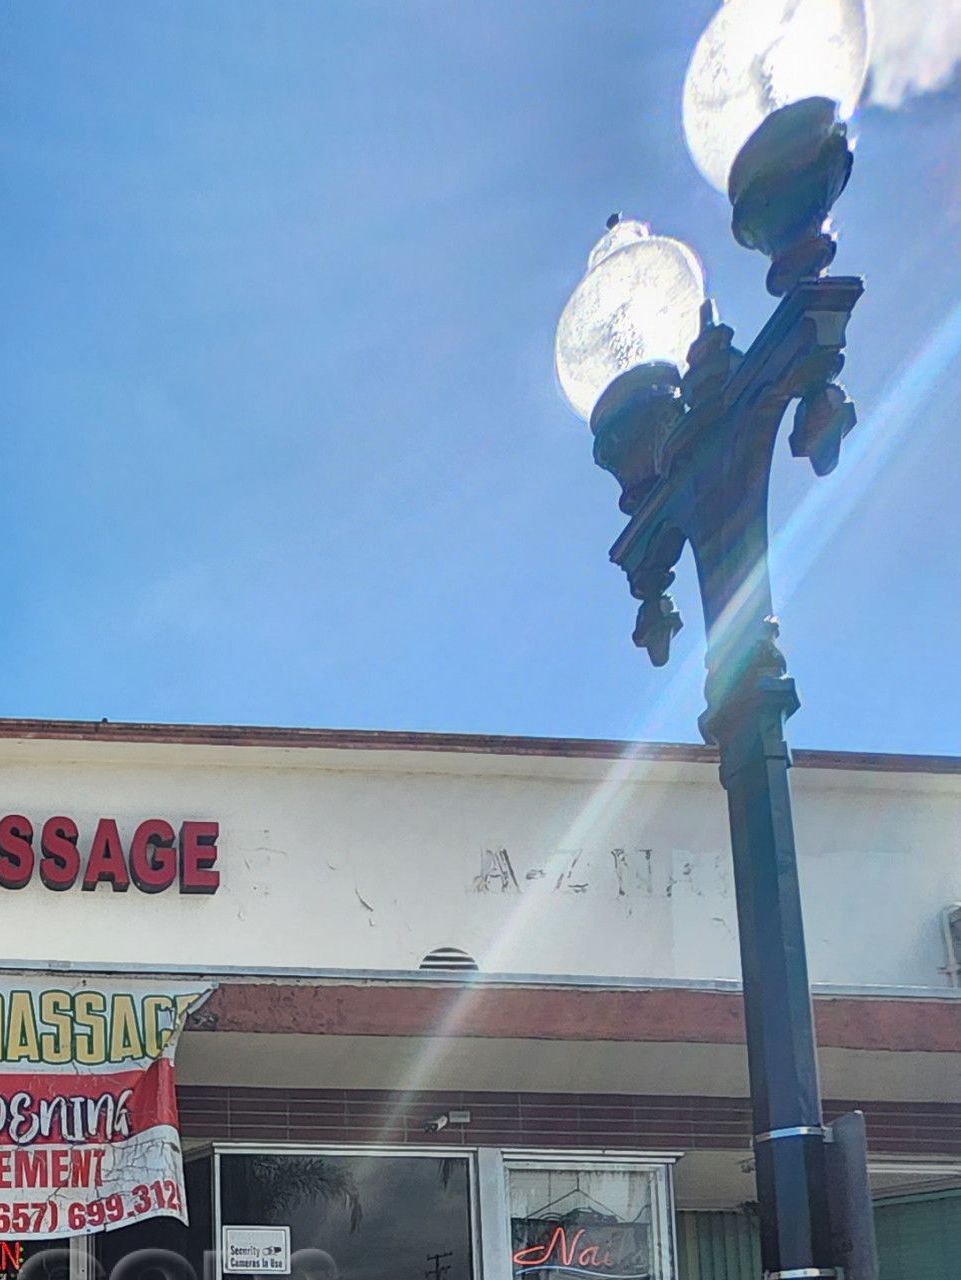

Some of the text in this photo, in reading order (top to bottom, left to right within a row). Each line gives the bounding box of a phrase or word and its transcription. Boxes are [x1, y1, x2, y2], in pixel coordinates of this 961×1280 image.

[67, 1180, 182, 1231] 699.312
[230, 1245, 260, 1258] Security
[230, 1257, 260, 1268] Cameras
